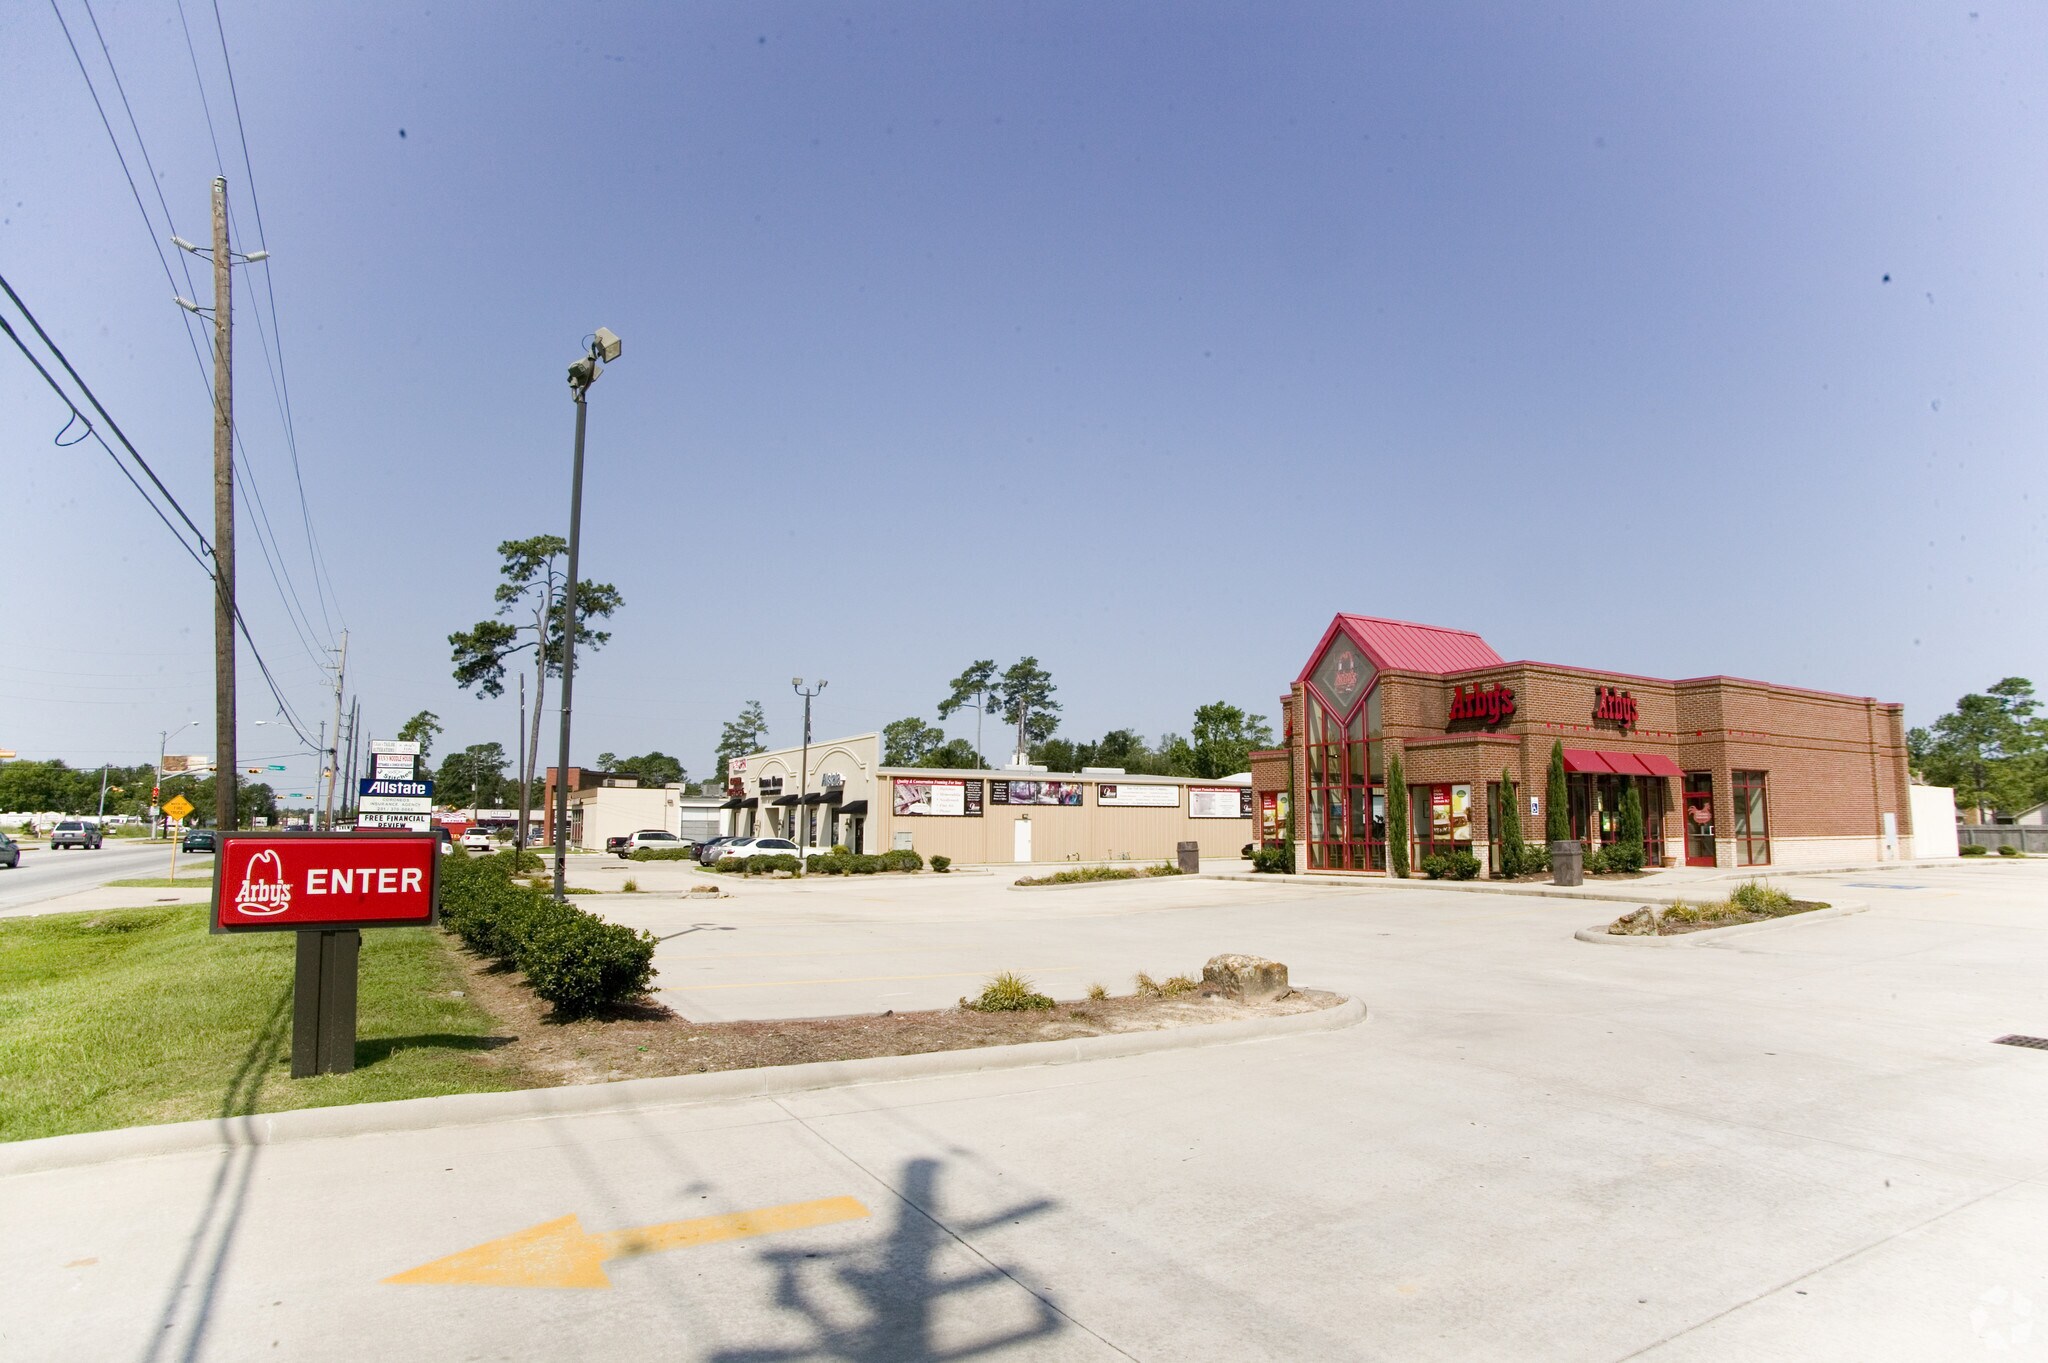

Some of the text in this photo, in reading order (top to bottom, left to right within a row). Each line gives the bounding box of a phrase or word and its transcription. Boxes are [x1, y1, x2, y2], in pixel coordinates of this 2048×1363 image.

[1449, 682, 1514, 723] Arby's
[1597, 686, 1638, 728] Arby's
[368, 781, 426, 794] Allstate
[235, 867, 422, 908] Arby's ENTER
